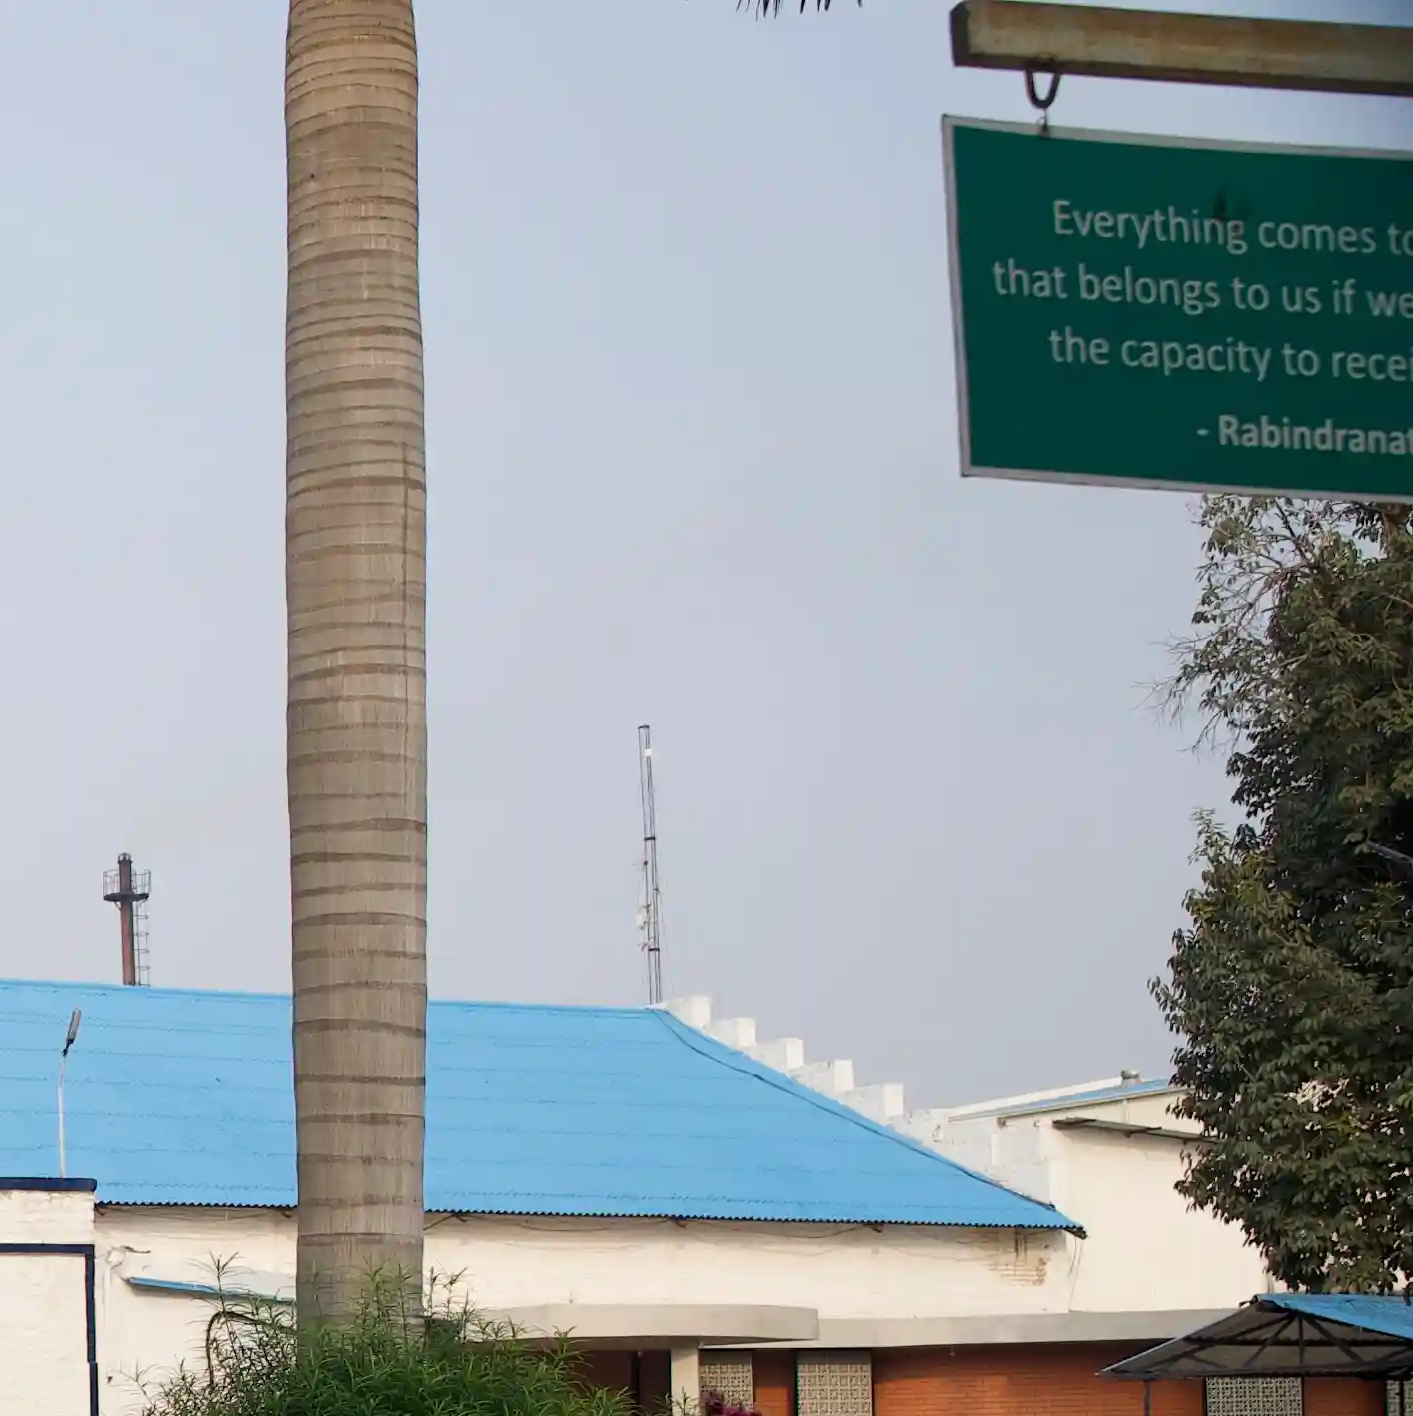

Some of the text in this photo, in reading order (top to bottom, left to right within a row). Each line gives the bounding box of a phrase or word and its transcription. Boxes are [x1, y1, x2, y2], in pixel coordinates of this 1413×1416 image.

[1052, 199, 1249, 255] Everything
[1258, 221, 1377, 254] comes
[992, 257, 1413, 320] that belongs to us if we
[1048, 325, 1110, 366] the
[1121, 336, 1271, 382] capacity
[1281, 343, 1320, 378] to
